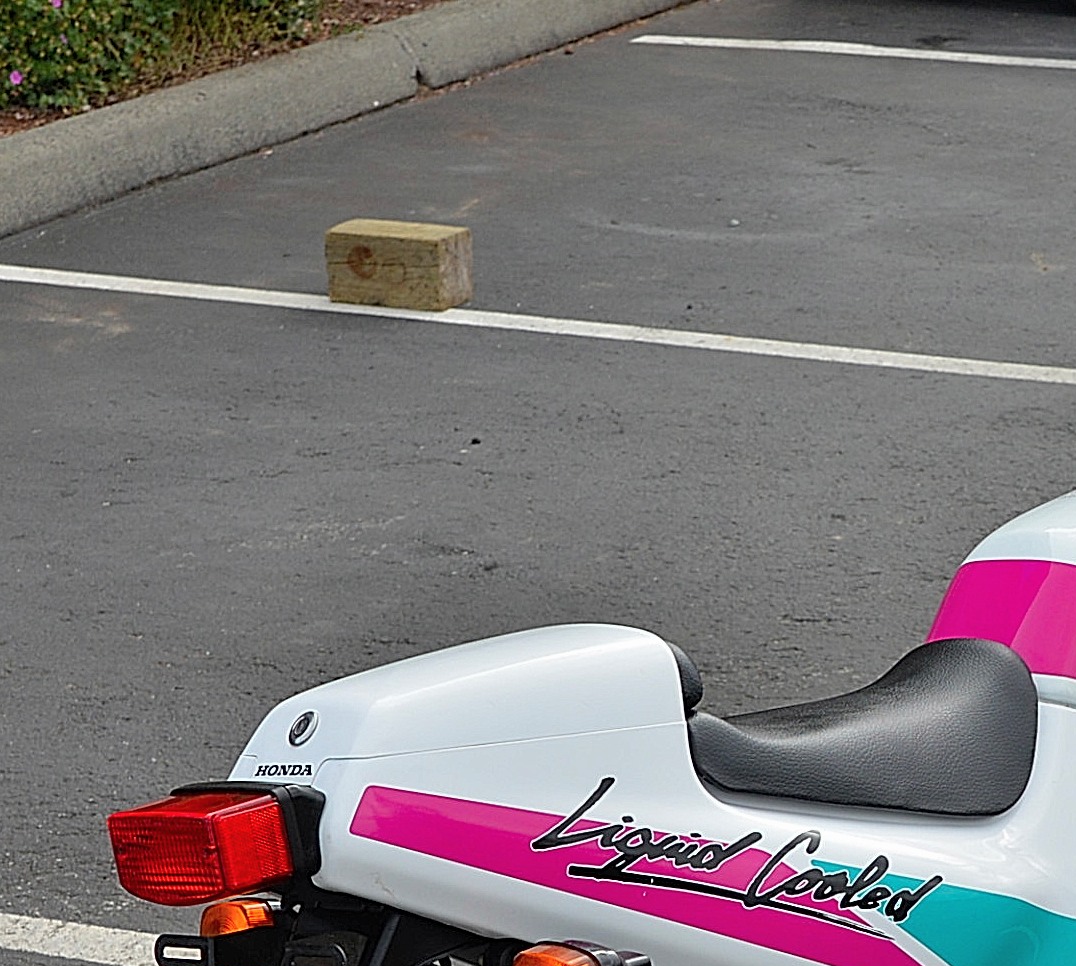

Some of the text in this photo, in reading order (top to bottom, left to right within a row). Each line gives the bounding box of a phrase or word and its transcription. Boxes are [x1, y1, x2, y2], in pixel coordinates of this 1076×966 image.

[254, 764, 313, 777] HONDA
[531, 777, 943, 923] Liquid Cooled
